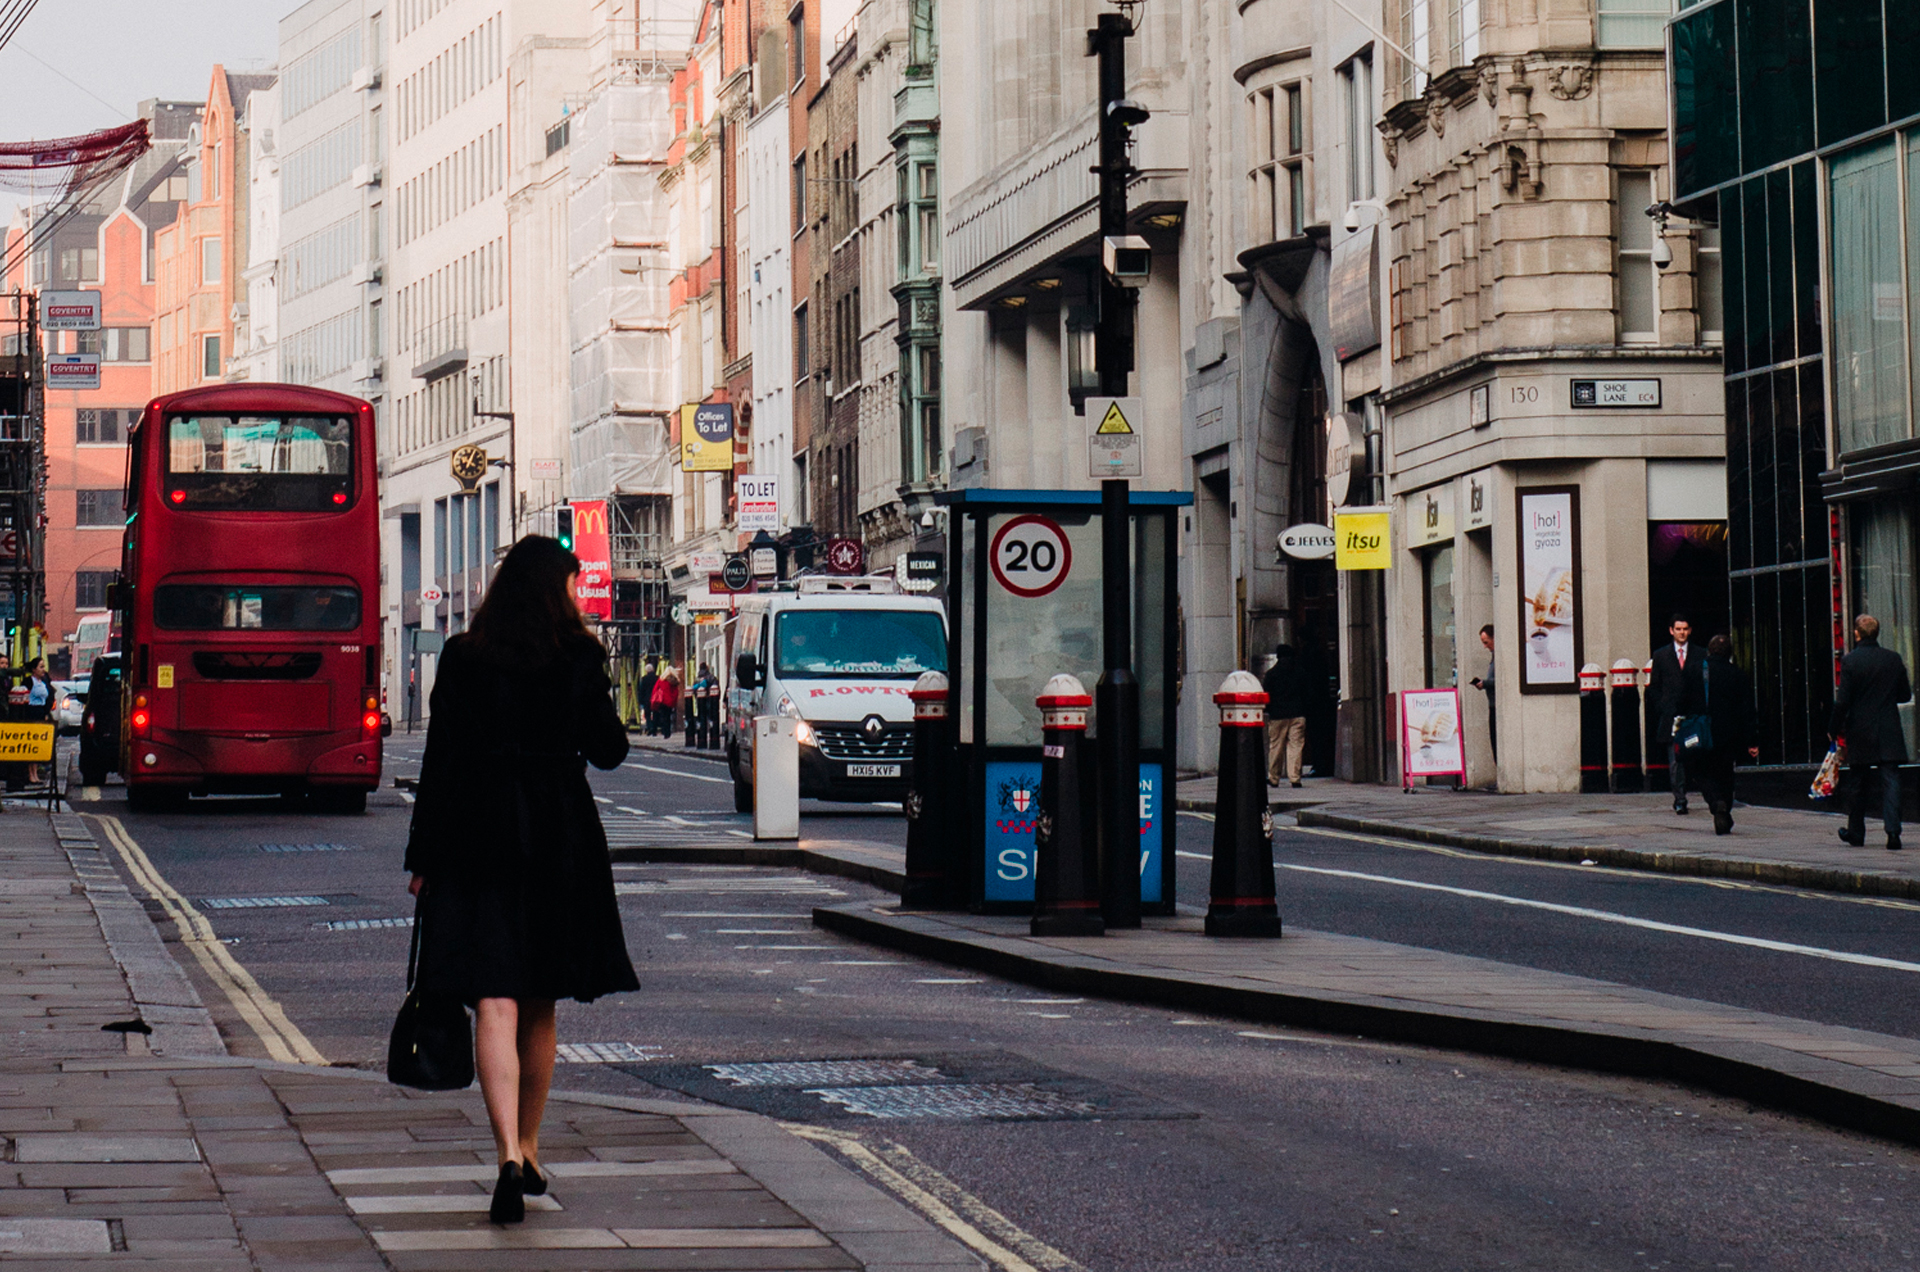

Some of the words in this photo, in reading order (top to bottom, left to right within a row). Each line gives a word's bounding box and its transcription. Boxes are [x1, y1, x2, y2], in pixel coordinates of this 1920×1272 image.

[50, 307, 92, 315] COVENTRY
[1603, 384, 1627, 392] SHOE
[1511, 386, 1538, 403] 130
[1603, 394, 1627, 402] LANE
[1638, 393, 1654, 401] EC4
[697, 411, 725, 422] Offices
[697, 422, 710, 433] To
[712, 421, 728, 433] Let
[741, 482, 755, 497] TO
[757, 482, 775, 497] LET
[1298, 536, 1335, 547] JEEVES
[1346, 531, 1381, 550] itsu
[1535, 538, 1561, 550] gyoza
[1005, 540, 1056, 573] 20
[910, 560, 937, 570] MEXICAN
[726, 567, 747, 575] PAUL
[586, 574, 601, 584] as
[577, 585, 610, 598] Usual
[876, 765, 894, 776] KVF
